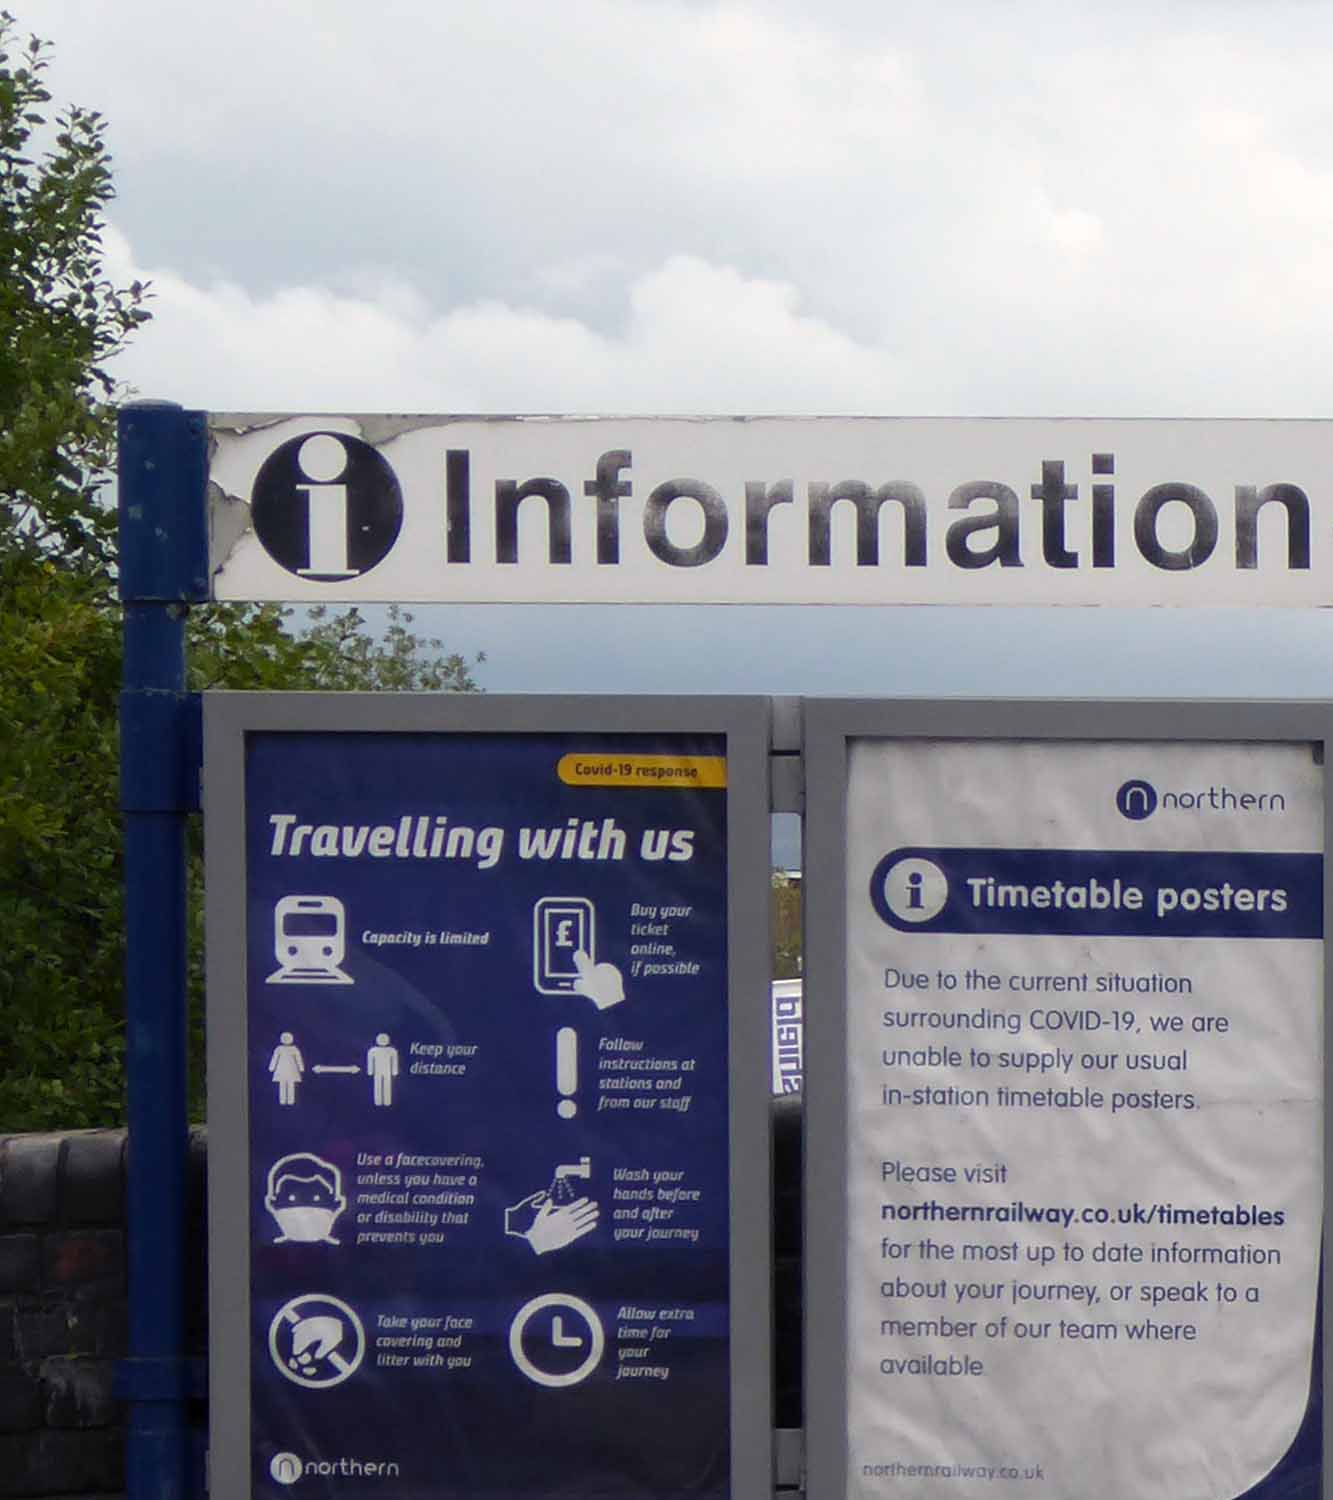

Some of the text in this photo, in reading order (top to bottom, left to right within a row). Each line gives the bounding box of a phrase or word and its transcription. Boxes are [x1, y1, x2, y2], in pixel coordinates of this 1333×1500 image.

[445, 449, 1311, 572] Information
[574, 762, 698, 783] Covid-19 response
[1161, 786, 1285, 811] northern
[269, 814, 695, 870] Travelling with us
[966, 876, 1288, 918] Timetable posters
[630, 902, 693, 920] Buy your
[361, 929, 490, 947] Capacity is limited
[630, 922, 670, 936] ticket
[630, 960, 701, 977] if possible
[884, 967, 1193, 994] Due to the current situation
[882, 1007, 1229, 1035] surrounding COVID-19, we are
[409, 1041, 479, 1059] Keep your
[598, 1036, 644, 1052] Follow
[409, 1061, 467, 1075] distance
[598, 1057, 696, 1071] instructions at
[882, 1045, 1187, 1074] unable to supply our usual
[598, 1076, 683, 1090] stations and
[597, 1095, 692, 1113] from our staff
[882, 1083, 990, 1107] in-station
[996, 1086, 1105, 1109] timetable
[356, 1171, 478, 1189] unless you have a
[612, 1167, 685, 1185] Wash your
[880, 1160, 1008, 1184] Please visit
[356, 1191, 475, 1205] medical condition
[612, 1186, 701, 1204] hands before
[356, 1209, 470, 1227] or disability that
[612, 1206, 675, 1223] and after
[881, 1199, 1285, 1229] northernrailway.co.uk/timetables
[356, 1231, 445, 1246] prevents you
[613, 1226, 700, 1242] your journey
[880, 1238, 1281, 1267] for the most up to date information
[879, 1276, 1260, 1308] about your journey, or speak to a
[880, 1314, 1197, 1341] member of our team where
[304, 1457, 400, 1476] northern
